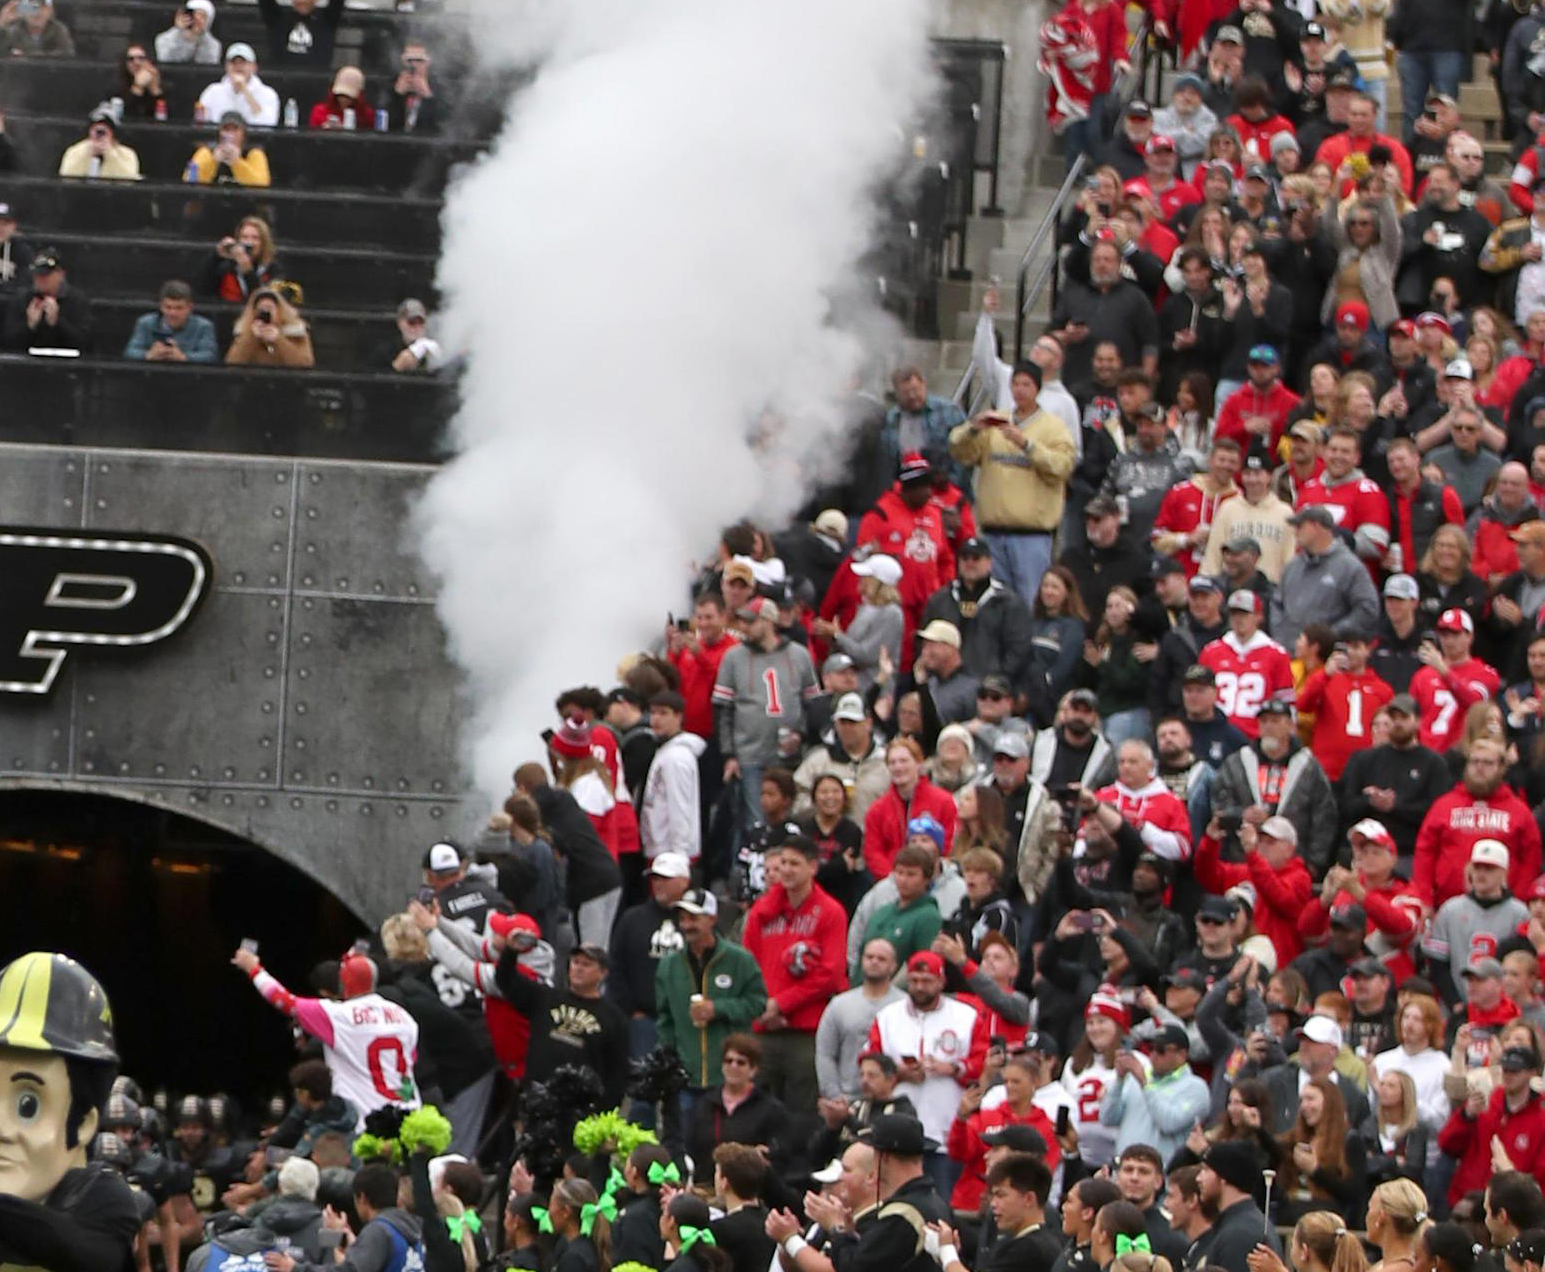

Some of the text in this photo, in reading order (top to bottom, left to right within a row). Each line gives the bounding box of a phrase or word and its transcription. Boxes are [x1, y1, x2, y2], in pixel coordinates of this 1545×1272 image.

[763, 667, 783, 716] 1
[1214, 671, 1266, 718] 32
[1345, 690, 1364, 737] 1
[1431, 689, 1458, 736] 7
[1077, 1078, 1104, 1122] 2
